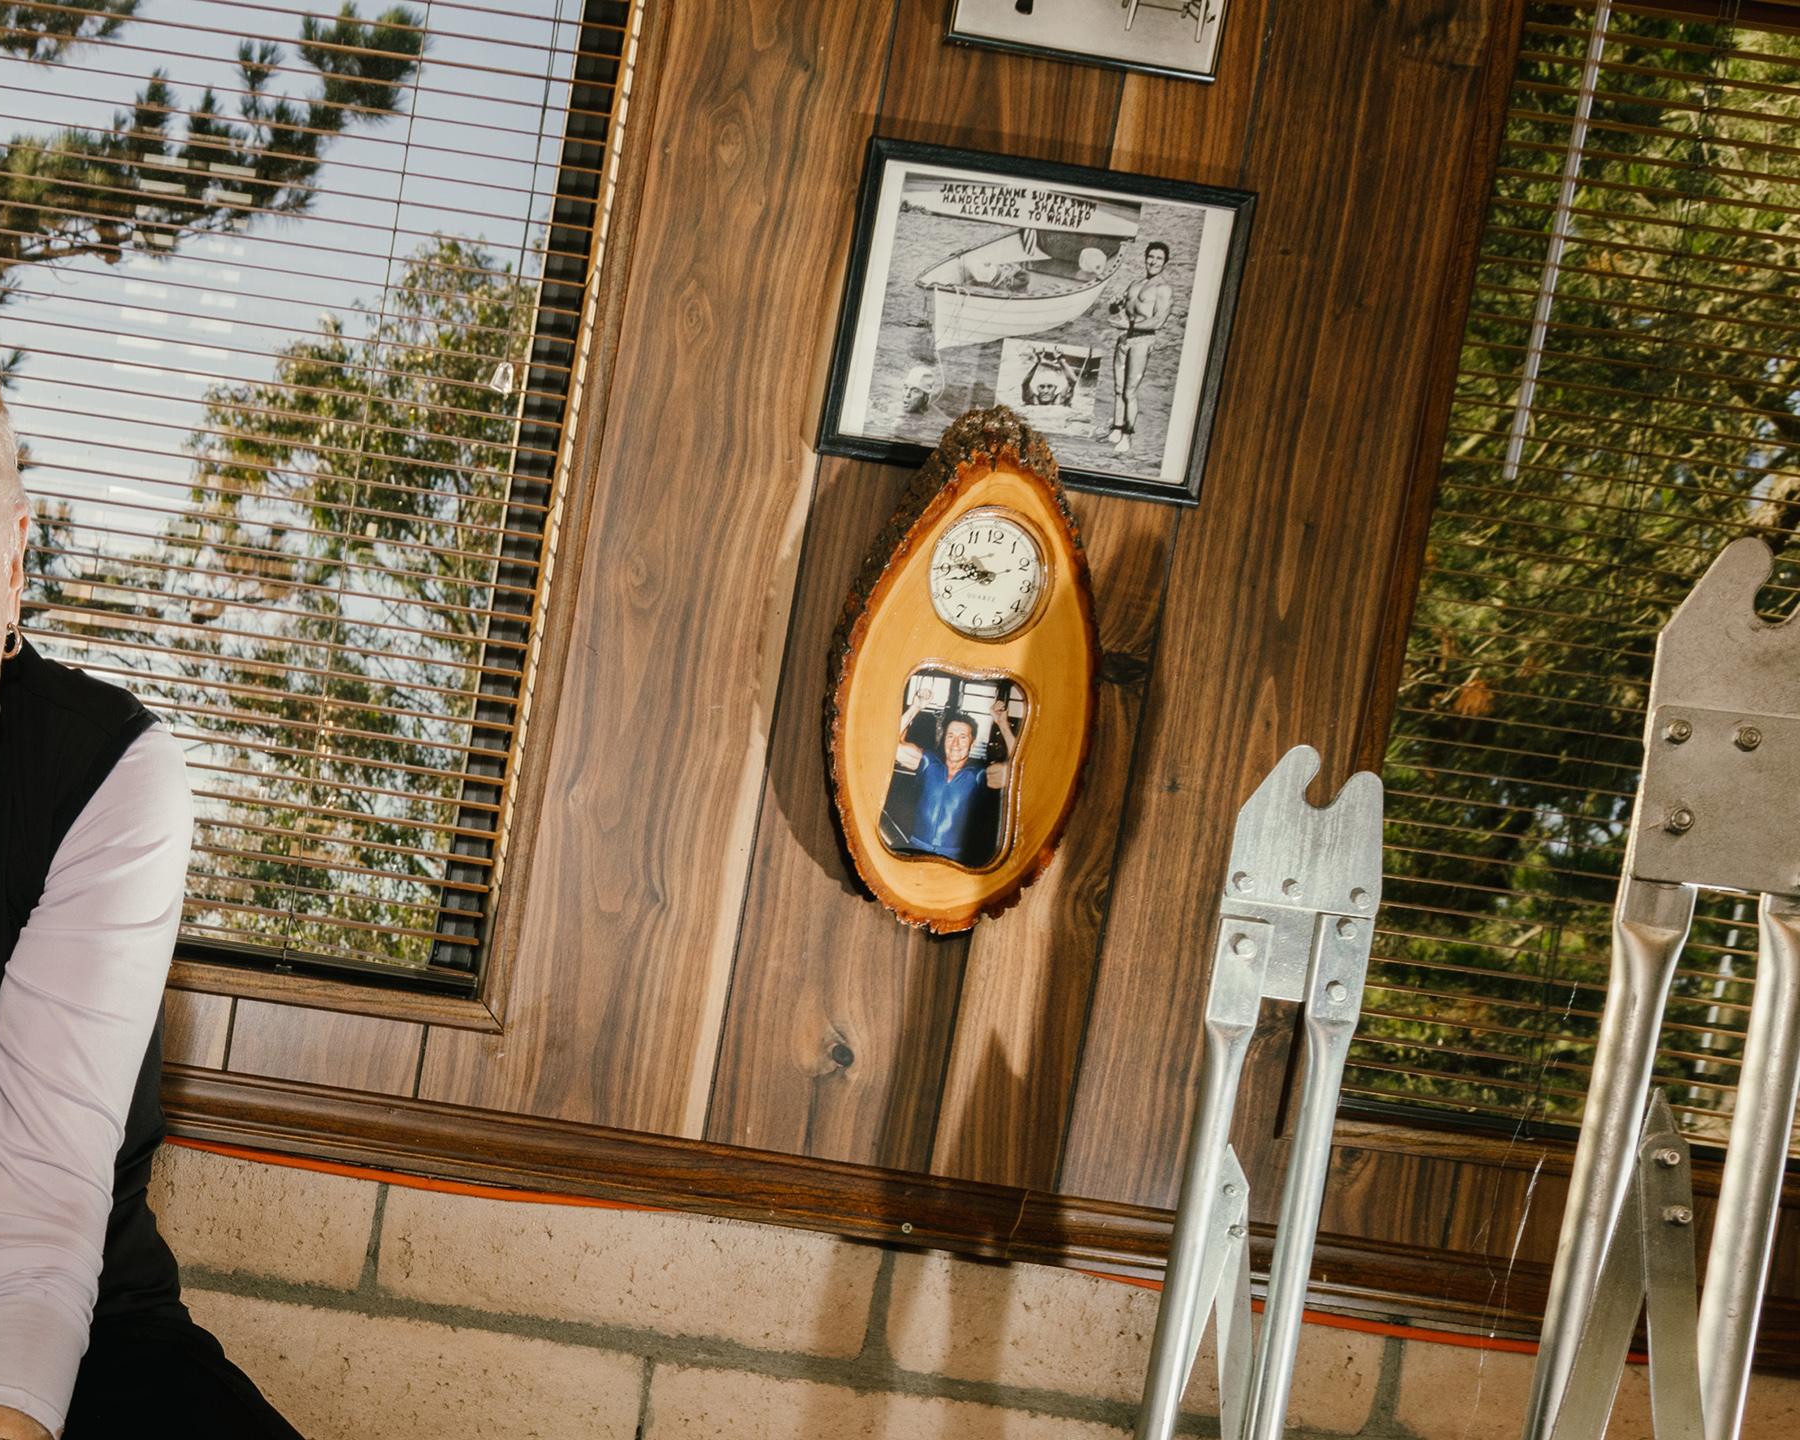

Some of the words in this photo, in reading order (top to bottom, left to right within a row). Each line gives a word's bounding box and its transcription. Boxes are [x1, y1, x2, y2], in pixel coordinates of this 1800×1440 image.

[940, 183, 968, 194] JACK
[972, 184, 986, 195] LA
[1032, 191, 1068, 205] SUPER
[1070, 198, 1097, 212] SWIM
[942, 194, 1016, 208] HANDCUFFED
[960, 205, 1020, 218] ALCATRAZ
[1028, 210, 1042, 222] TO
[1047, 214, 1083, 228] WHARF
[968, 531, 980, 544] 11
[988, 529, 1004, 545] 12
[948, 543, 965, 558] 10
[1011, 541, 1017, 554] 1
[940, 562, 951, 576] 9
[1019, 557, 1030, 571] 2
[942, 585, 952, 600] 8
[1020, 580, 1031, 594] 3
[956, 604, 967, 618] 7
[1010, 599, 1021, 613] 4
[972, 613, 982, 627] 6
[992, 612, 1003, 625] 5
